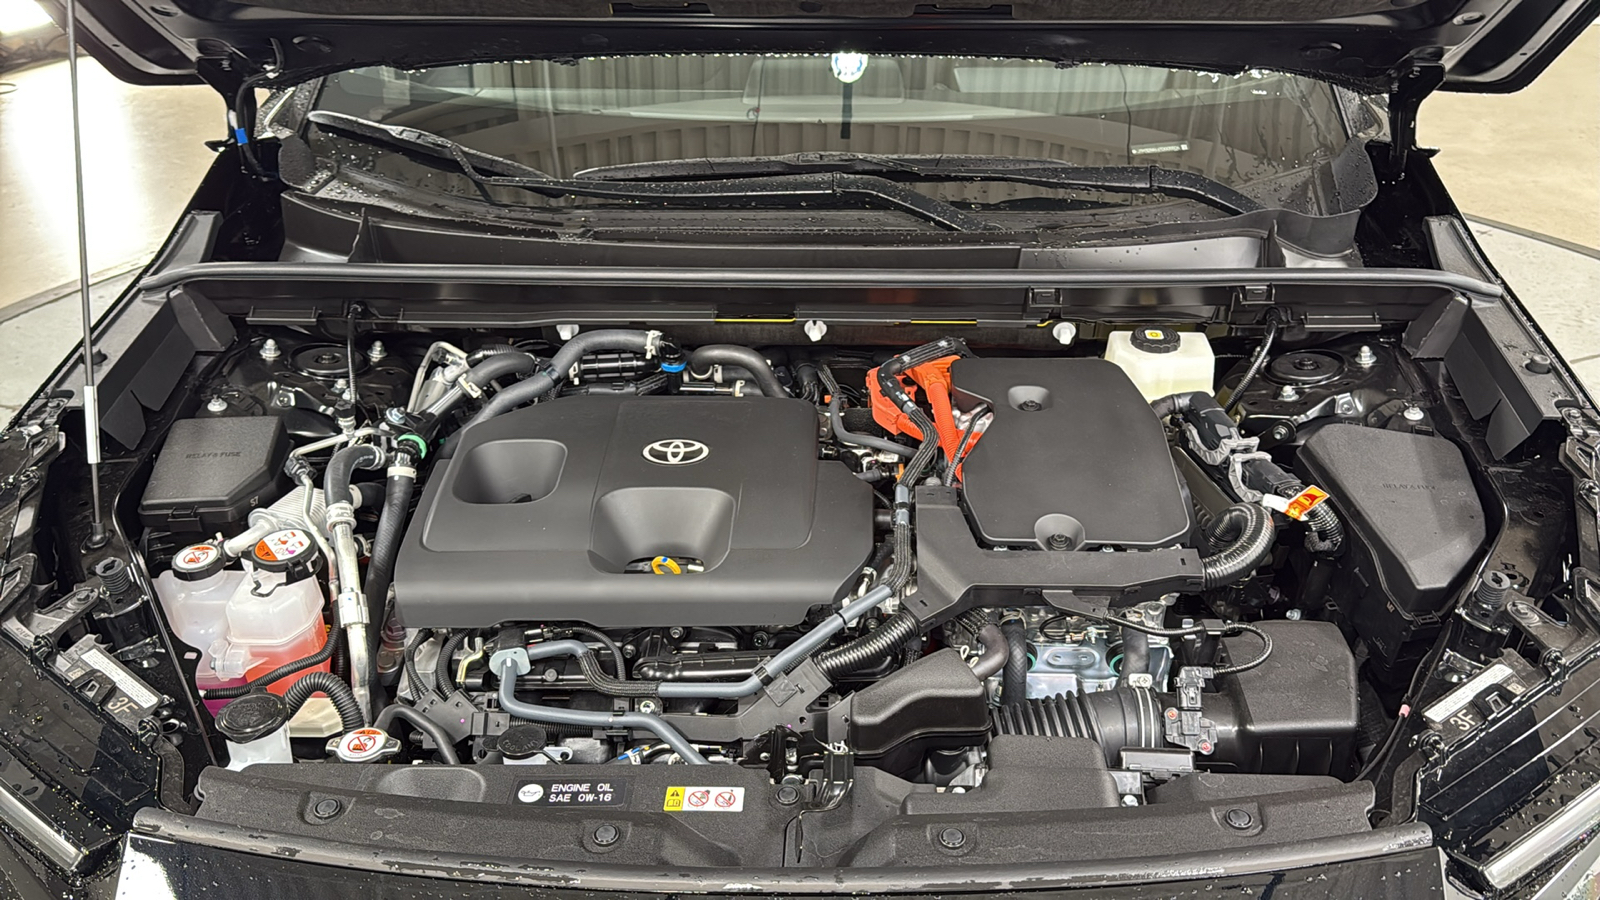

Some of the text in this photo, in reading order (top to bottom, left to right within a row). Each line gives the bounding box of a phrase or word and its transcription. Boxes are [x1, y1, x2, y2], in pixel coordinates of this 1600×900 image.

[107, 697, 139, 714] 3F
[1449, 709, 1476, 731] 3F
[502, 739, 539, 751] COOLANT
[551, 783, 614, 793] ENGINE OIL
[548, 793, 612, 803] SAE 0W-16
